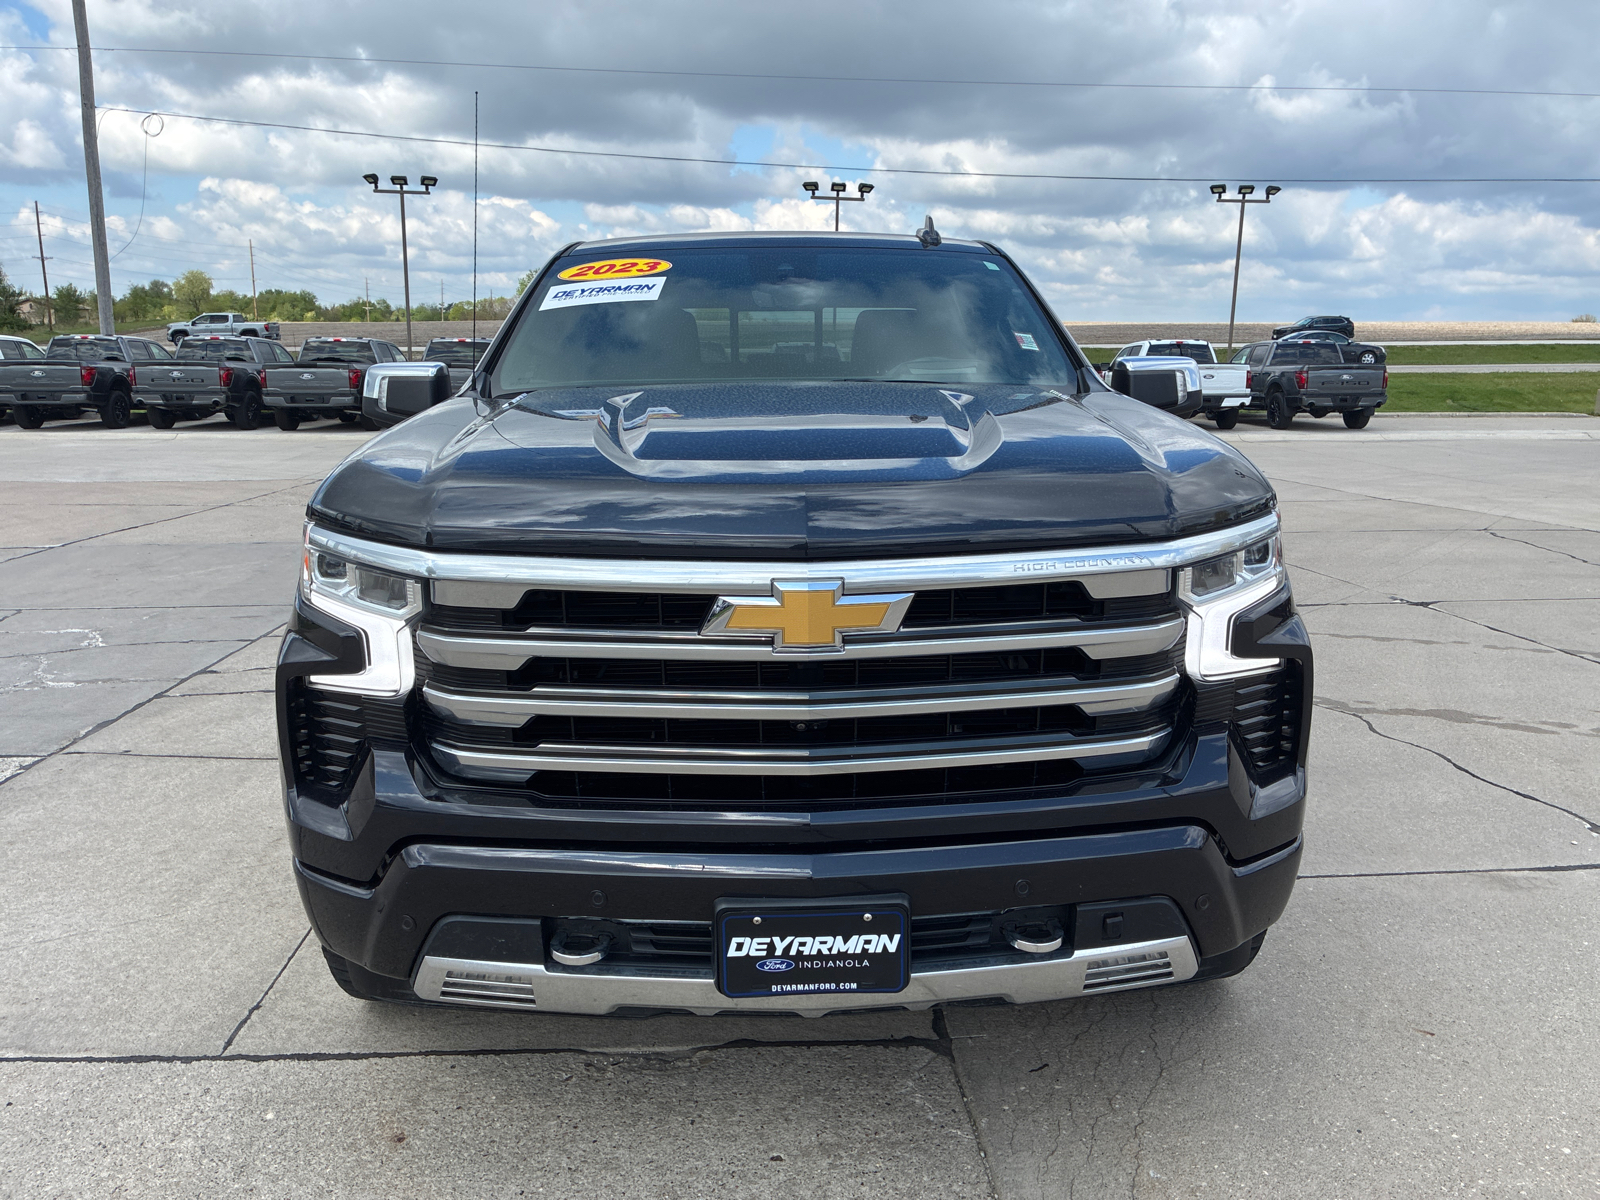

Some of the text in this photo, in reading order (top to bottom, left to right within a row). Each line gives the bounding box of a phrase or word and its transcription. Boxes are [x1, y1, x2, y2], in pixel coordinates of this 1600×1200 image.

[567, 262, 662, 278] 2023
[552, 284, 657, 299] DEYARMAN
[1013, 555, 1147, 572] HIGH COUNTRY
[727, 934, 901, 957] DEYARMAN
[763, 959, 870, 970] Ford INDIANOLA
[771, 982, 858, 992] DEYARMANFORD.COM
